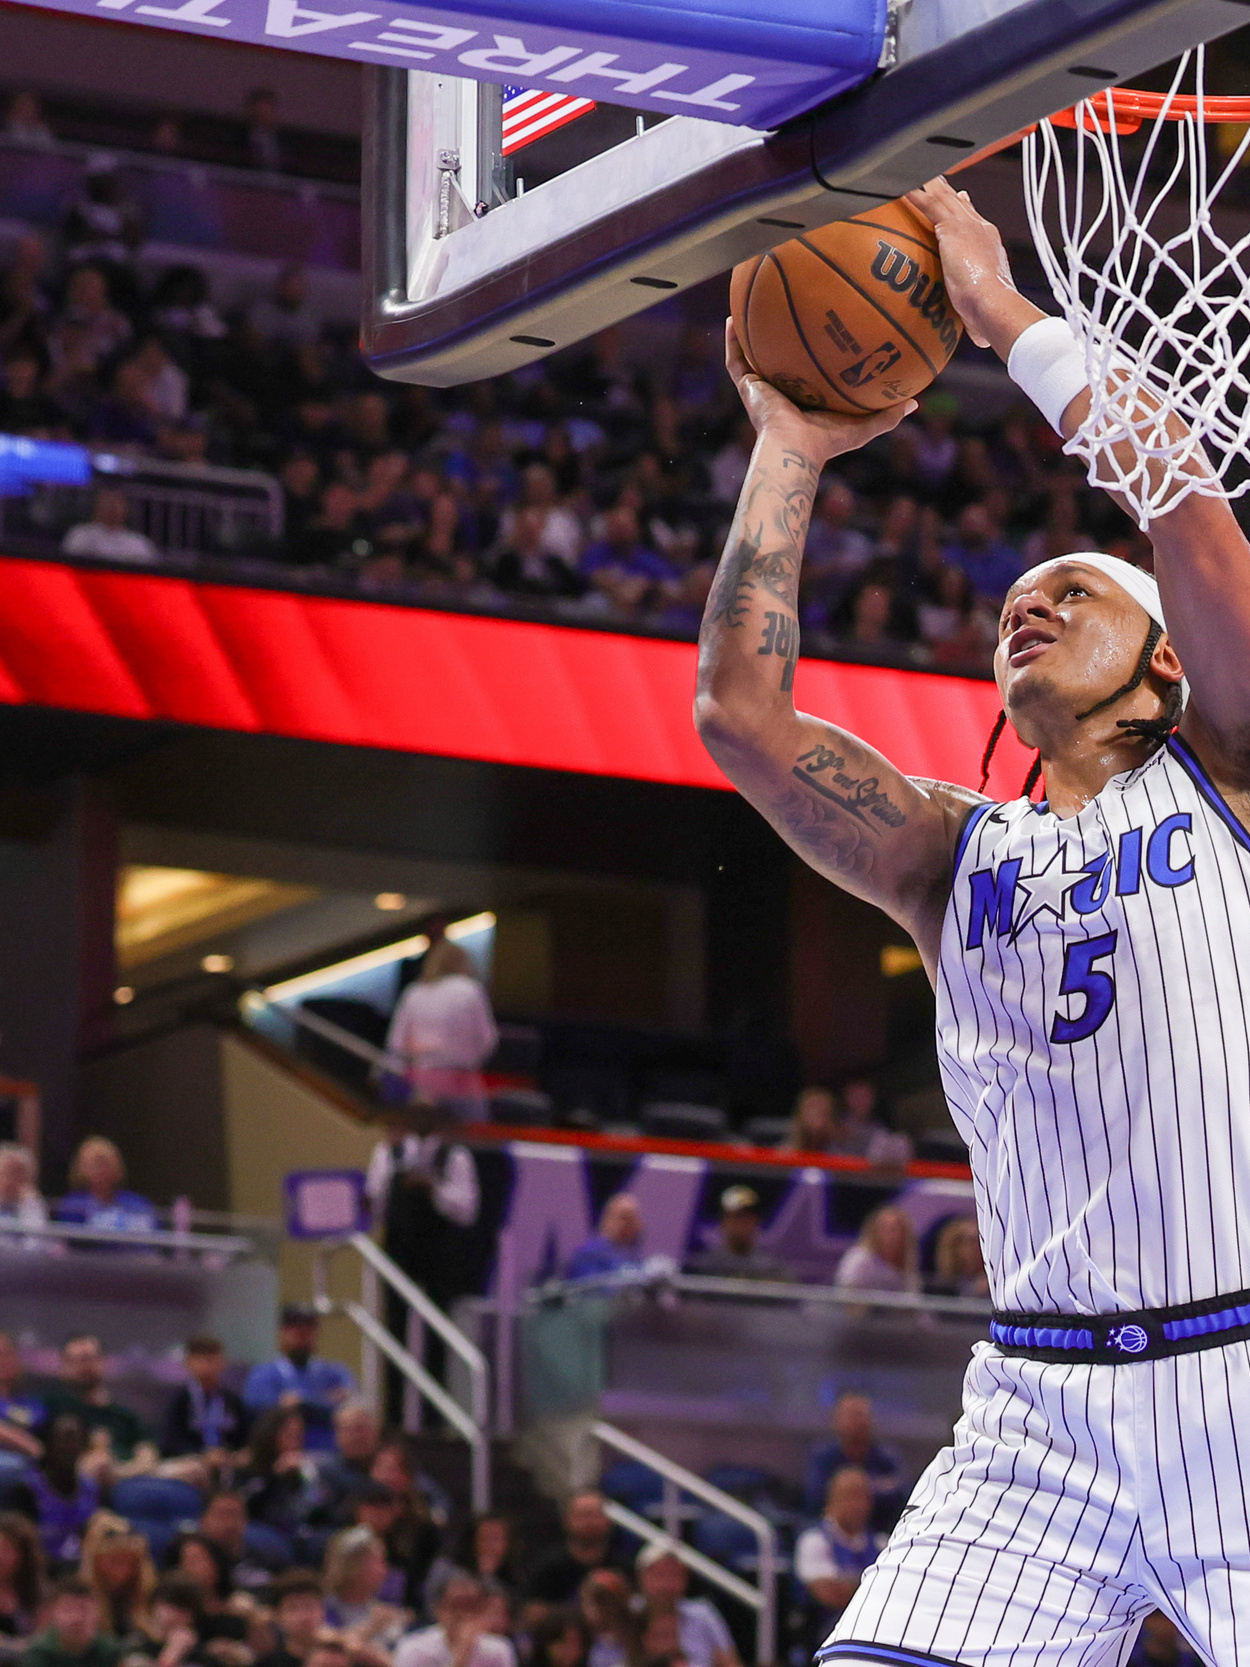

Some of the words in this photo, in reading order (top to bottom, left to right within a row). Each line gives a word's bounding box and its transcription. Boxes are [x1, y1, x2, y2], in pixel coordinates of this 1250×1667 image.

[96, 0, 756, 112] THREAT
[870, 239, 960, 360] Wilson
[1050, 928, 1118, 1044] 5
